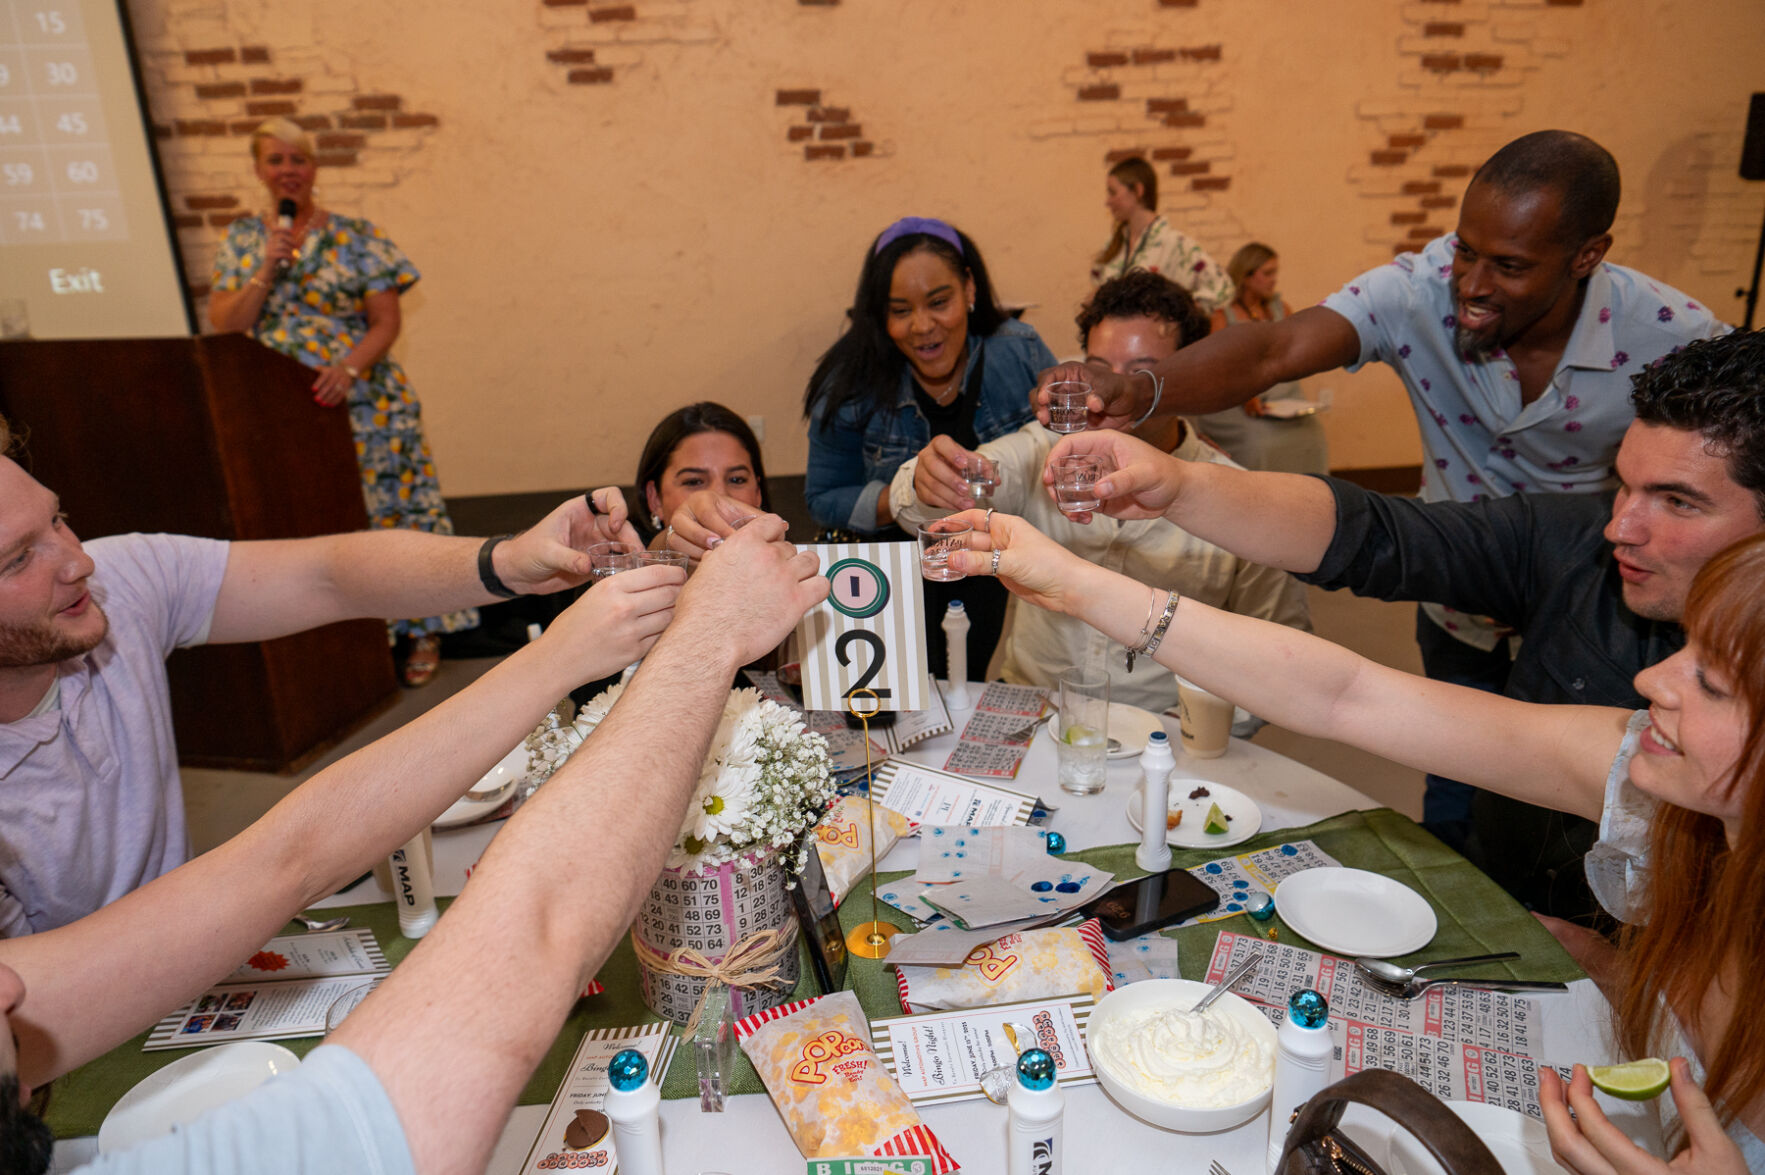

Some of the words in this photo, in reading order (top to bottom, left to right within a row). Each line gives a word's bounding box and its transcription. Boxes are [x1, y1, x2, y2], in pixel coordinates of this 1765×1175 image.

[35, 10, 65, 34] 15
[46, 61, 77, 86] 30
[57, 111, 88, 135] 45
[3, 162, 33, 186] 59
[67, 160, 98, 184] 60
[13, 210, 45, 232] 74
[76, 207, 109, 232] 75
[48, 266, 104, 294] Exit
[835, 629, 892, 699] 2
[735, 873, 743, 884] 8
[750, 865, 763, 879] 30
[398, 866, 415, 906] MAP
[663, 879, 677, 890] 40
[681, 881, 697, 891] 60
[701, 879, 718, 890] 70
[734, 887, 748, 899] 12
[752, 880, 765, 892] 18
[767, 870, 778, 885] 35
[650, 888, 661, 901] 18
[664, 894, 679, 905] 43
[683, 896, 697, 906] 51
[703, 894, 719, 905] 75
[739, 903, 745, 913] 1
[752, 894, 766, 908] 23
[650, 904, 662, 916] 24
[685, 910, 700, 921] 48
[704, 909, 720, 920] 69
[739, 918, 747, 929] 9
[754, 909, 767, 923] 28
[769, 899, 780, 914] 37
[652, 918, 664, 931] 20
[668, 923, 680, 934] 41
[686, 925, 702, 936] 52
[706, 924, 722, 935] 73
[655, 933, 665, 944] 17
[670, 938, 683, 948] 42
[688, 940, 703, 950] 50
[707, 939, 723, 950] 64
[1238, 938, 1249, 949] 73
[1234, 949, 1244, 958] 51
[1268, 944, 1278, 954] 68
[1242, 974, 1254, 984] 29
[1252, 941, 1263, 950] 70
[1264, 955, 1275, 965] 53
[1297, 952, 1308, 961] 65
[1231, 959, 1241, 968] 37
[1280, 959, 1291, 969] 50
[1295, 962, 1306, 972] 58
[1338, 962, 1349, 970] 75
[1277, 969, 1288, 979] 43
[1292, 975, 1304, 983] 31
[1336, 972, 1347, 982] 56
[660, 979, 671, 990] 16
[675, 983, 689, 994] 42
[1258, 978, 1270, 987] 19
[1274, 982, 1285, 991] 16
[1352, 977, 1363, 986] 51
[1289, 985, 1301, 994] 28
[1334, 984, 1345, 993] 37
[1351, 987, 1361, 997] 42
[1445, 985, 1457, 995] 62
[1462, 990, 1474, 999] 61
[661, 992, 673, 1004] 29
[744, 991, 756, 1002] 12
[1332, 995, 1343, 1005] 28
[1445, 997, 1456, 1006] 47
[1480, 992, 1491, 1002] 63
[1497, 995, 1508, 1006] 64
[747, 1005, 755, 1015] 7
[761, 995, 774, 1009] 27
[1348, 999, 1359, 1009] 23
[1365, 1003, 1376, 1012] 21
[1462, 1000, 1473, 1010] 53
[1480, 1003, 1491, 1013] 48
[1514, 998, 1526, 1010] 75
[677, 1011, 690, 1022] 37
[1272, 1008, 1284, 1020] 62
[1382, 1006, 1393, 1015] 17
[1399, 1010, 1410, 1020] 30
[1444, 1008, 1456, 1018] 44
[1462, 1011, 1473, 1021] 37
[1497, 1007, 1508, 1018] 50
[1515, 1011, 1526, 1021] 46
[1381, 1016, 1392, 1027] 12
[1444, 1020, 1455, 1030] 23
[1497, 1020, 1509, 1030] 32
[1367, 1028, 1378, 1040] 68
[1461, 1024, 1473, 1034] 24
[1480, 1027, 1491, 1038] 17
[1515, 1024, 1527, 1034] 41
[922, 1026, 938, 1055] Night!
[1384, 1030, 1395, 1043] 69
[1402, 1035, 1413, 1047] 61
[1443, 1032, 1455, 1042] 11
[1497, 1032, 1509, 1043] 16
[1516, 1036, 1527, 1046] 18
[1366, 1041, 1378, 1053] 49
[1419, 1037, 1431, 1050] 73
[1437, 1041, 1449, 1055] 70
[1384, 1045, 1395, 1057] 56
[1402, 1048, 1413, 1060] 50
[897, 1041, 912, 1078] Welcome!
[1366, 1055, 1377, 1066] 39
[1420, 1052, 1431, 1064] 54
[1438, 1056, 1449, 1068] 46
[1484, 1051, 1497, 1064] 62
[1503, 1055, 1515, 1068] 73
[832, 1060, 868, 1074] FRESH!
[931, 1055, 945, 1085] Bingo
[1384, 1059, 1395, 1070] 41
[1521, 1059, 1534, 1072] 63
[1420, 1066, 1431, 1078] 44
[1438, 1070, 1450, 1082] 32
[1485, 1066, 1498, 1078] 52
[1504, 1070, 1516, 1082] 48
[1523, 1074, 1536, 1086] 60
[1439, 1084, 1451, 1097] 26
[1487, 1080, 1499, 1093] 40
[1506, 1086, 1518, 1097] 41
[1508, 1100, 1521, 1112] 28
[1527, 1104, 1540, 1116] 29
